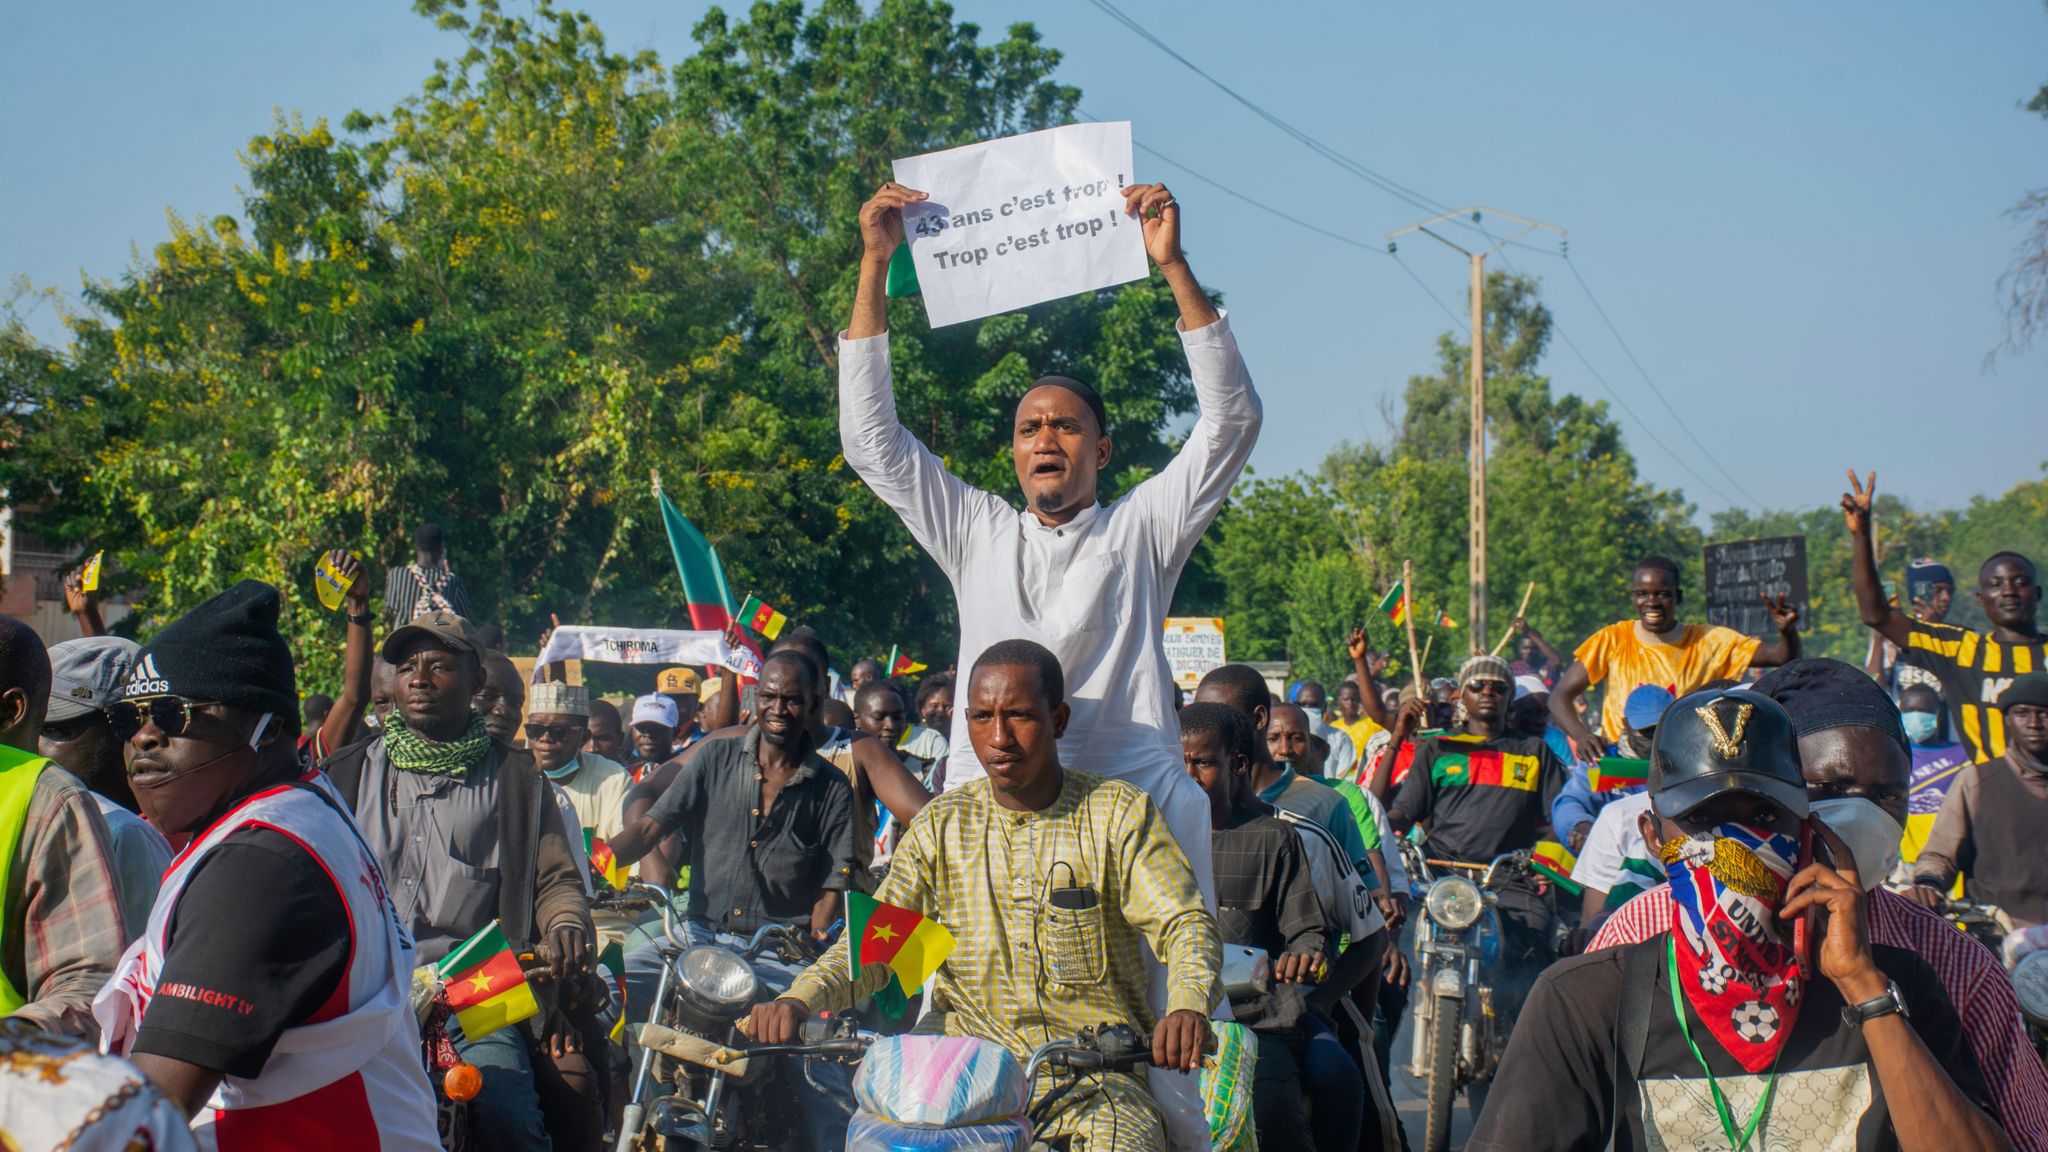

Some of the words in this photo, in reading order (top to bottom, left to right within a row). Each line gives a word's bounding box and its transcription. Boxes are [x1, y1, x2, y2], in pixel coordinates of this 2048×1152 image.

[915, 214, 945, 236] 43
[952, 207, 994, 229] ans
[999, 189, 1056, 217] c'est
[1062, 177, 1110, 203] trop
[1117, 173, 1125, 188] !
[933, 244, 989, 270] Trop
[995, 227, 1050, 256] c'est
[1055, 215, 1104, 241] trop
[1109, 209, 1118, 227] !
[603, 639, 658, 652] TCHIROMA
[125, 678, 169, 696] adidas
[157, 982, 238, 1010] AMBILIGHT
